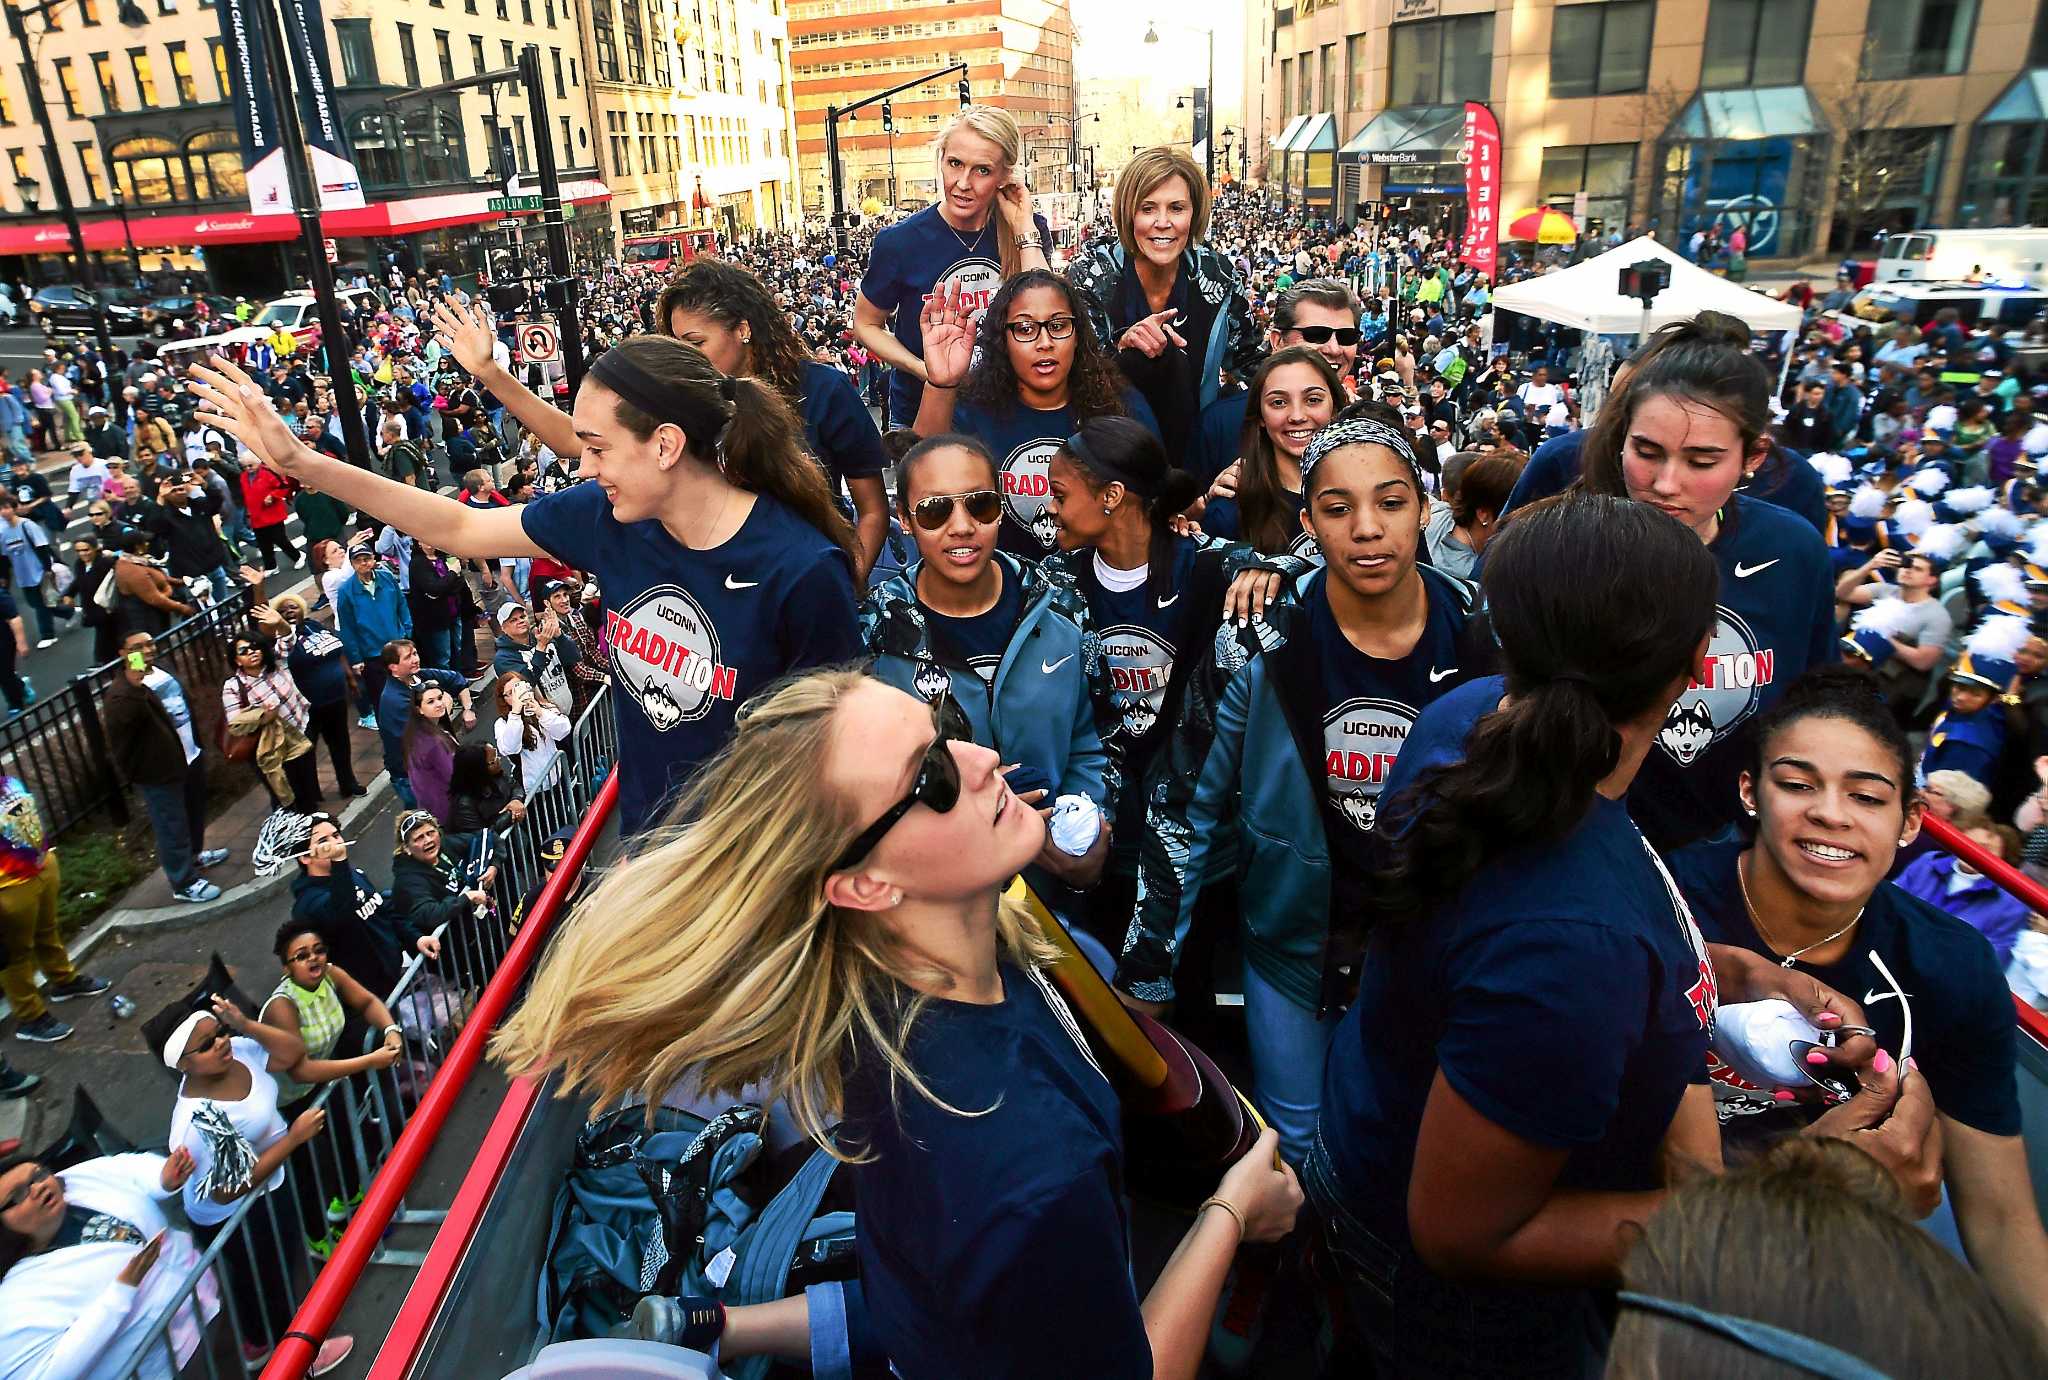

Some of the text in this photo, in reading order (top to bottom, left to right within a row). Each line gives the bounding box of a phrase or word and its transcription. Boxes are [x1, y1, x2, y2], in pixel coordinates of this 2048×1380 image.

[249, 100, 265, 147] PARADE
[315, 94, 334, 141] PARADE
[491, 196, 540, 211] ASYLUM ST
[657, 603, 697, 635] UCONN
[1104, 645, 1149, 656] UCONN
[1343, 721, 1406, 738] UCONN
